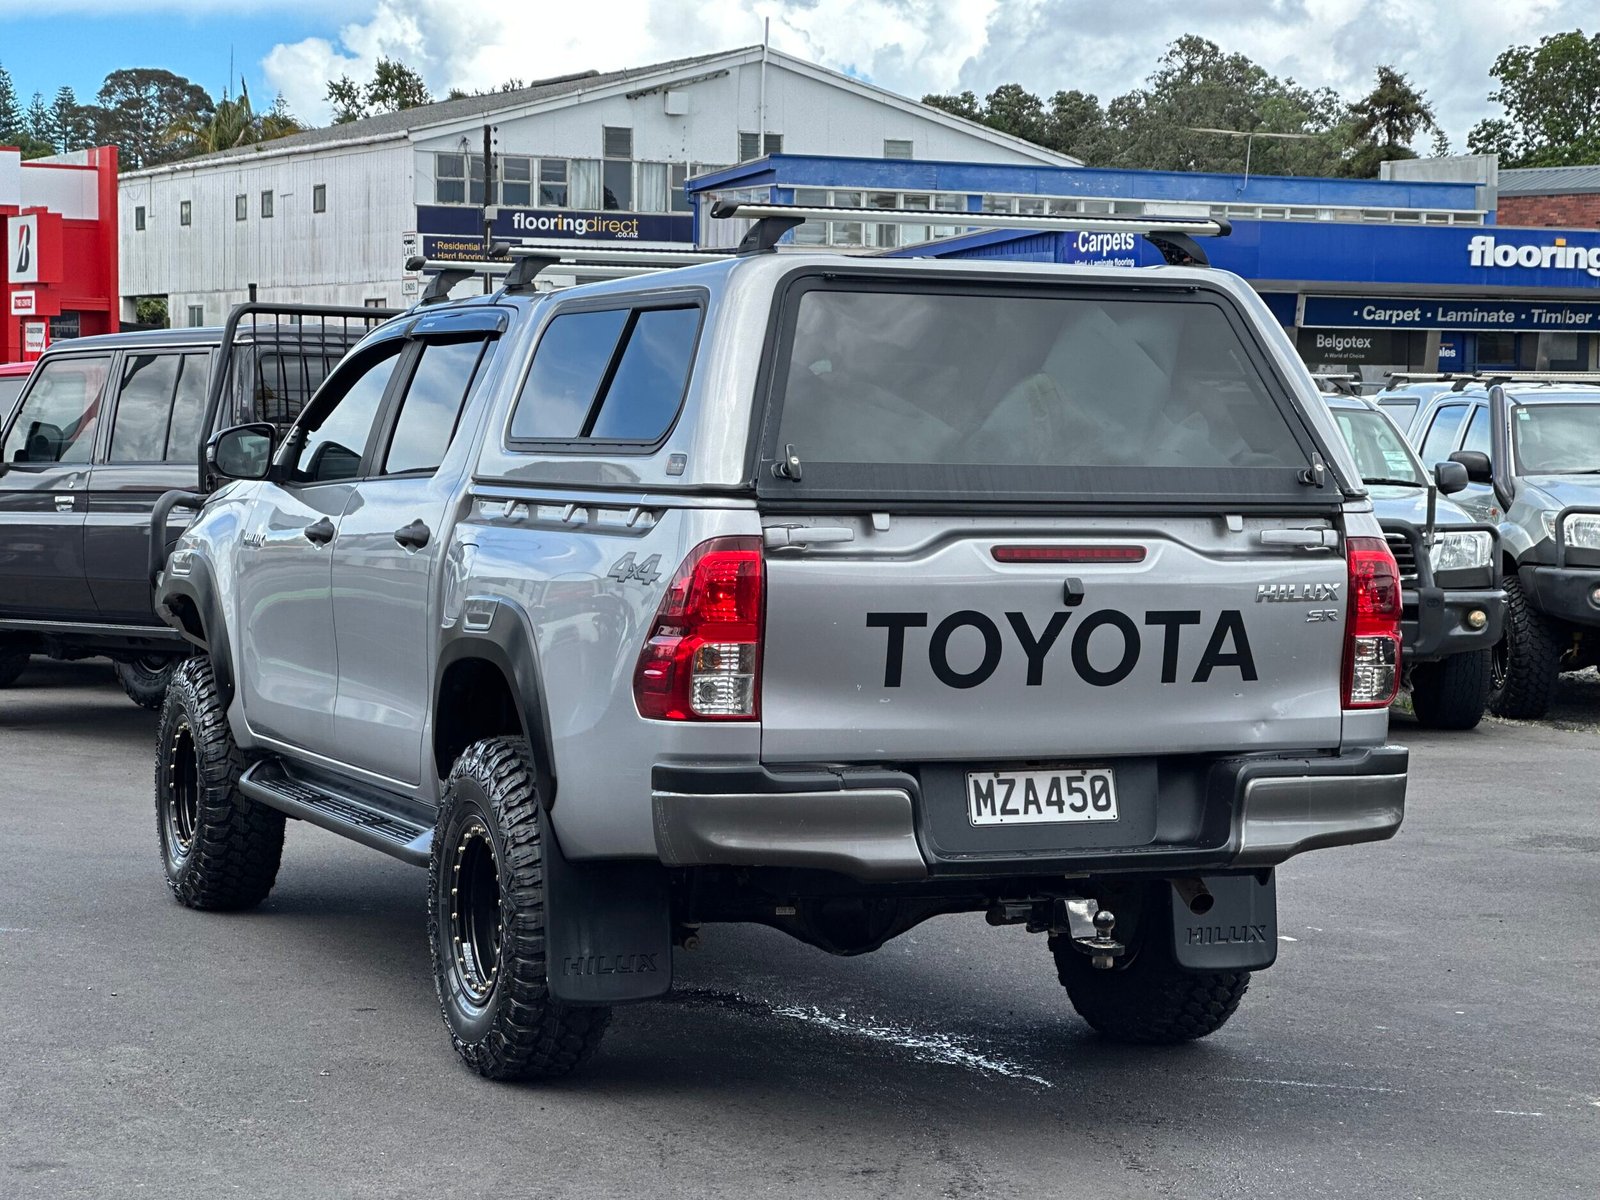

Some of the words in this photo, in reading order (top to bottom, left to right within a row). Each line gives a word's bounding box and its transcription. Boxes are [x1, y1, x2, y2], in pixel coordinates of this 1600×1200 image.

[437, 241, 480, 250] Residential
[1078, 231, 1135, 256] Carpets
[1362, 305, 1421, 324] Carpet
[1437, 307, 1515, 323] Laminate
[1531, 308, 1592, 324] Timber
[1316, 334, 1371, 351] Belgotex
[607, 551, 662, 586] 4x4
[1255, 583, 1341, 602] HILUX
[1305, 609, 1339, 622] SR
[866, 609, 1258, 689] TOYOTA
[973, 775, 1112, 816] MZA450
[1185, 924, 1267, 945] HILUX
[561, 953, 658, 976] HILUX
